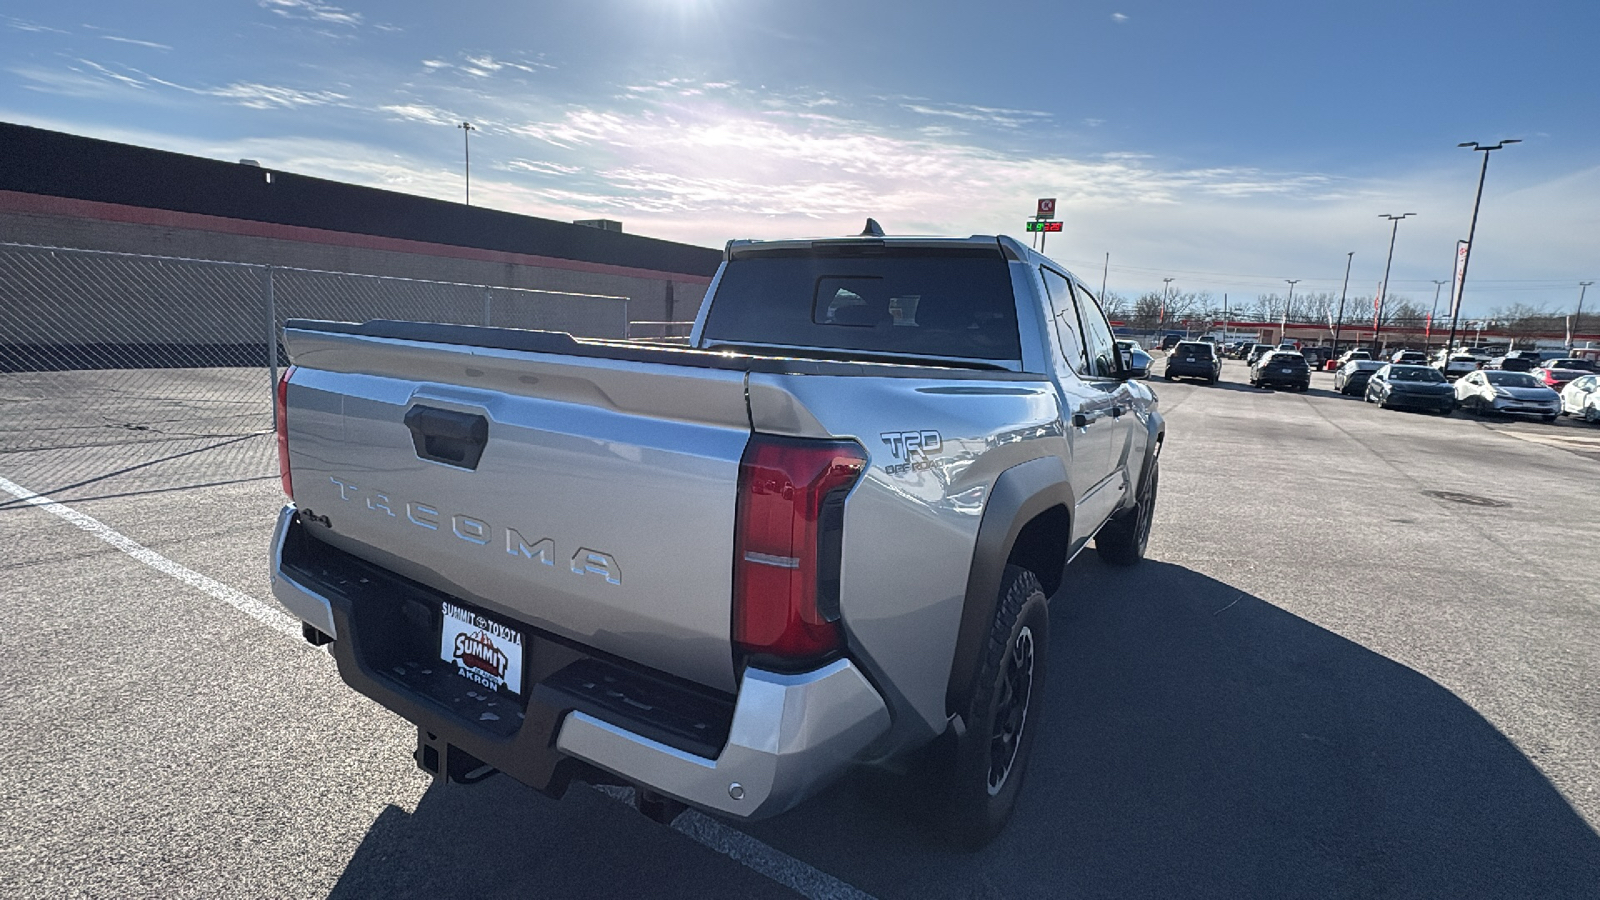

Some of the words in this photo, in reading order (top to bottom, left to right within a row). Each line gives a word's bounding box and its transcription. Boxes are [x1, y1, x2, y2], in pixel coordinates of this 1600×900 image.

[880, 429, 943, 462] TRD
[329, 476, 622, 586] TACOMA
[441, 601, 476, 625] SUMMIT
[487, 619, 522, 646] TOYOTA
[455, 635, 506, 675] SUMMIT
[458, 667, 498, 692] AKRON
